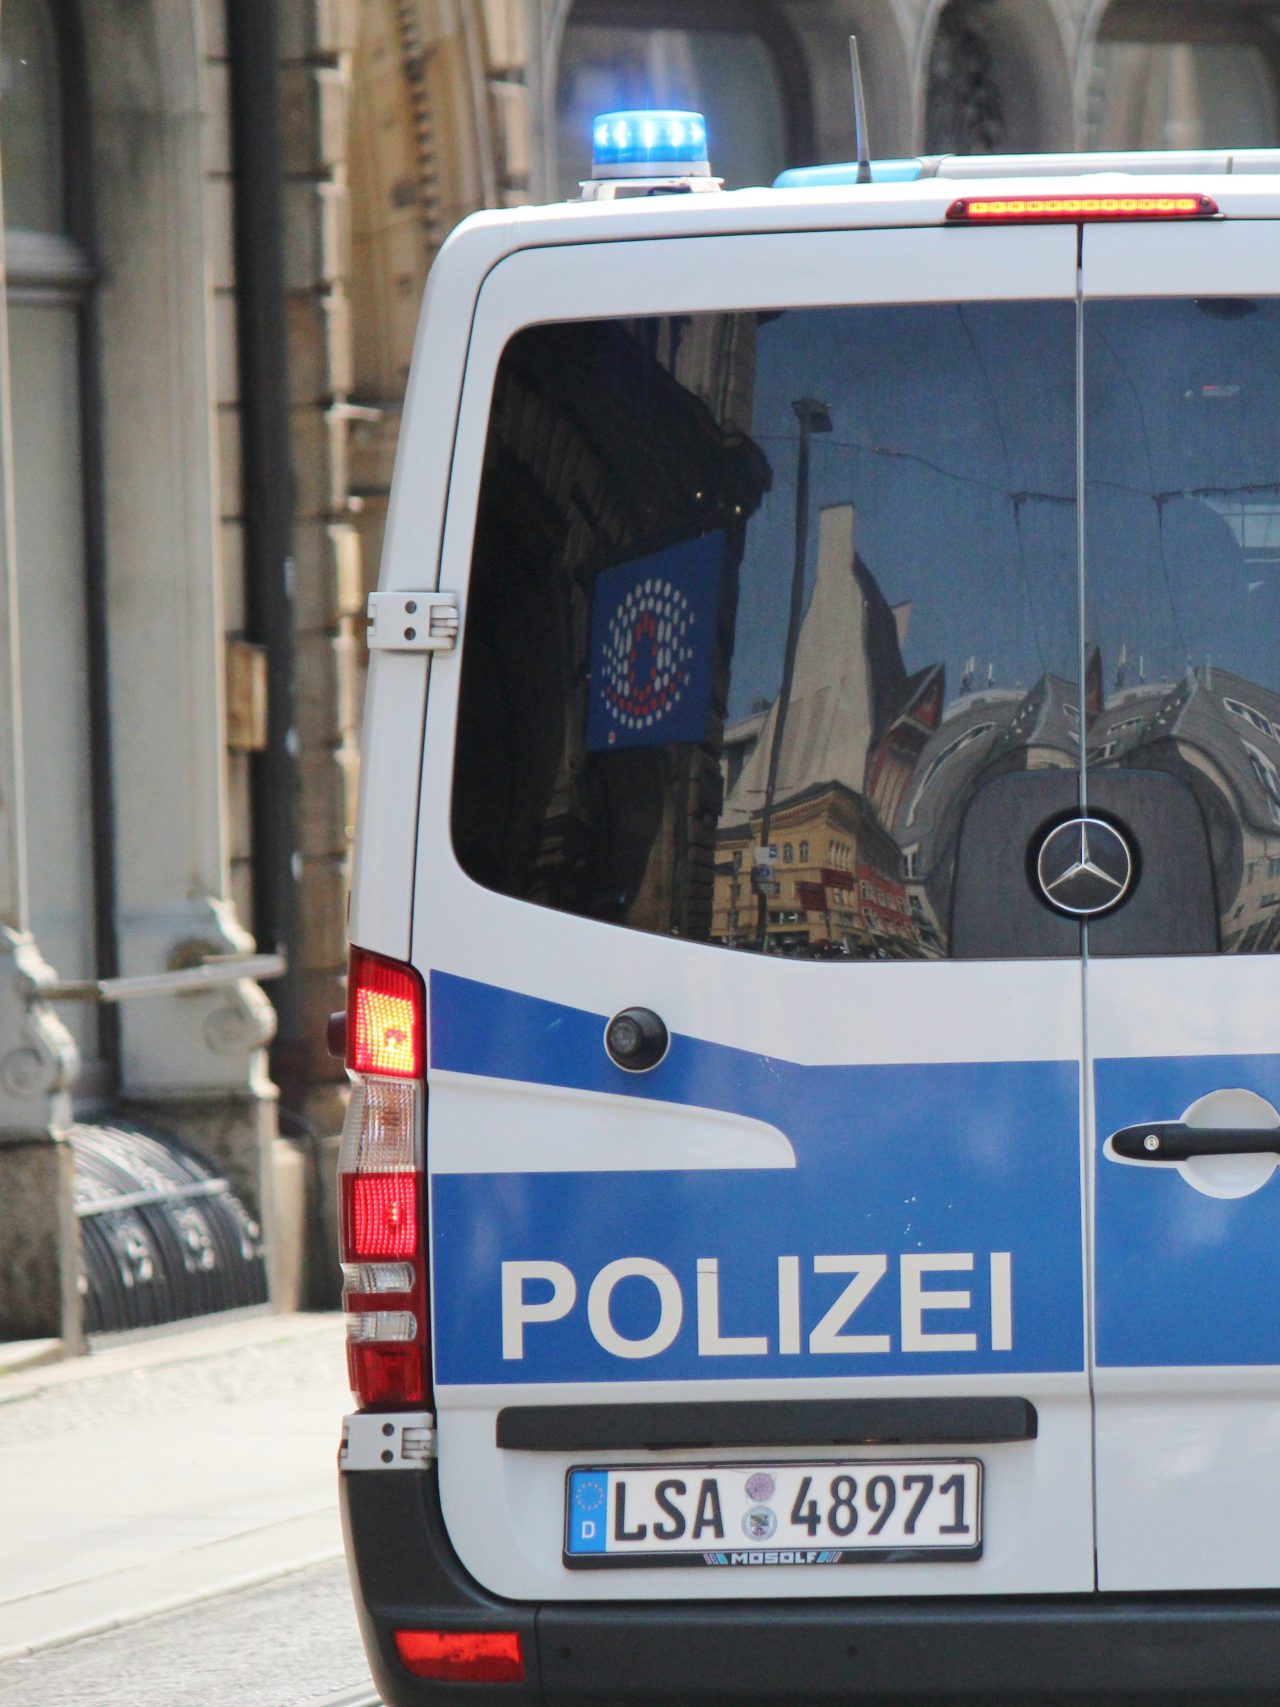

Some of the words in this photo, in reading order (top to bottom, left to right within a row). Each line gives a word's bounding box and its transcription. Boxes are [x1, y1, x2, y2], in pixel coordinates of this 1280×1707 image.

[501, 1252, 1013, 1360] POLIZEI
[614, 1478, 726, 1542] LSA
[790, 1473, 970, 1537] 48971
[580, 1520, 596, 1540] D
[730, 1551, 817, 1566] MOSOLF
